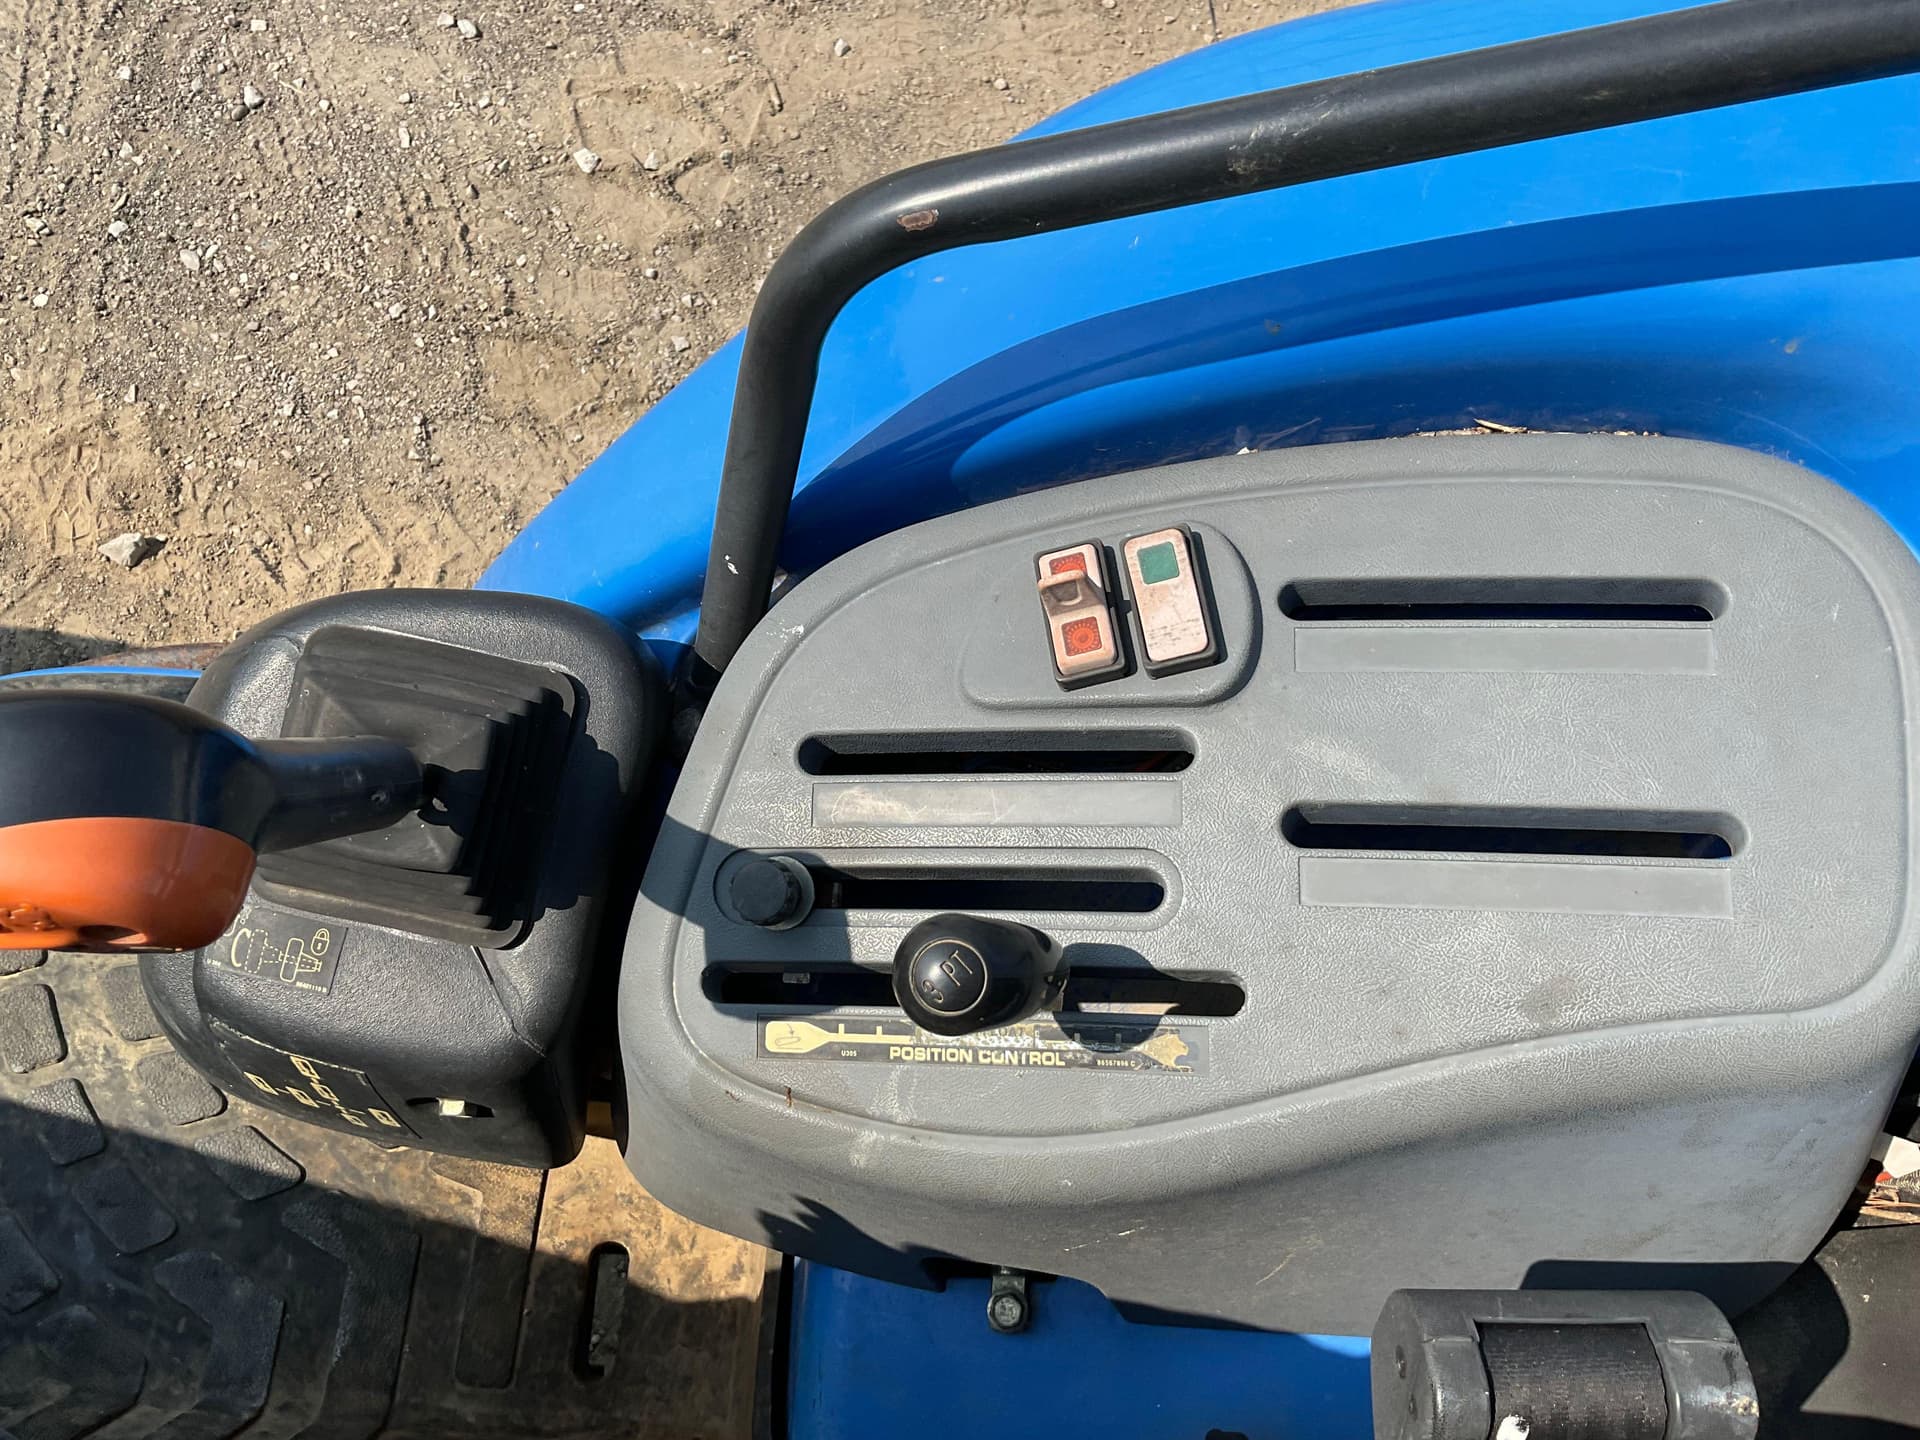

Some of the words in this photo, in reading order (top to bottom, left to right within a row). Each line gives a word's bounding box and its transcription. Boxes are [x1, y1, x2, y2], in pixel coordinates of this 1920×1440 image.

[921, 978, 944, 1004] 3
[939, 949, 973, 987] PT
[889, 1046, 973, 1063] POSITION
[978, 1050, 1066, 1067] CONTROL
